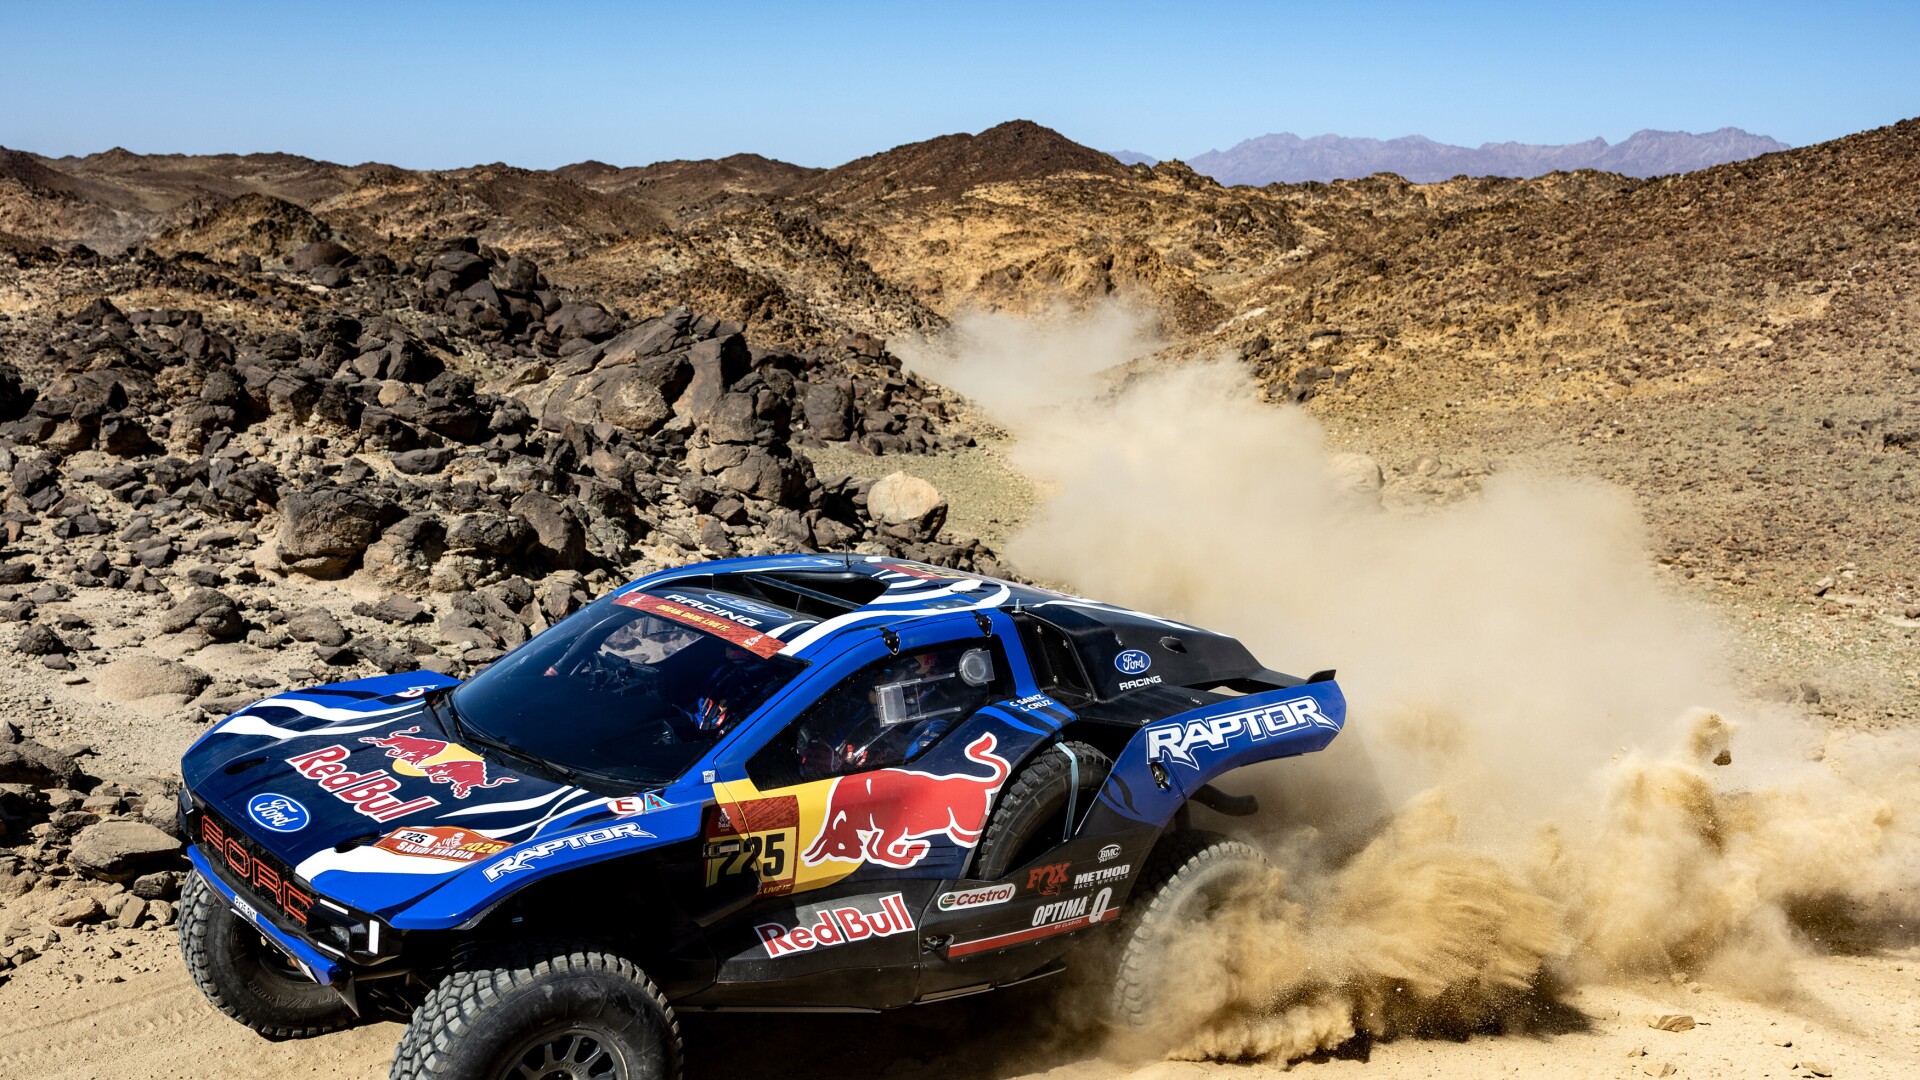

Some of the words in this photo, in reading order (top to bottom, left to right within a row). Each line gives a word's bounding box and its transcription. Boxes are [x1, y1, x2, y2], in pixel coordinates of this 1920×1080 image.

[664, 594, 762, 627] RACING
[1122, 653, 1145, 671] Ford
[1119, 675, 1162, 690] RACING
[1016, 694, 1045, 704] SAINZ
[1028, 699, 1054, 709] CRUZ
[1145, 696, 1342, 771] RAPTOR
[285, 744, 389, 793] Red
[335, 777, 441, 823] Bull
[254, 799, 299, 827] Ford
[400, 831, 428, 843] 225
[396, 841, 432, 855] SAUDI
[431, 847, 476, 860] ARABIA
[482, 822, 657, 882] RAPTOR
[1100, 847, 1120, 858] BMC
[1026, 861, 1072, 895] FOX
[1073, 881, 1095, 890] RACE
[1096, 874, 1129, 885] WHEELS
[1075, 864, 1130, 885] METHOD
[956, 886, 1013, 906] Castrol
[1031, 896, 1087, 927] OPTIMA
[755, 909, 845, 959] Red
[833, 893, 915, 942] Bull
